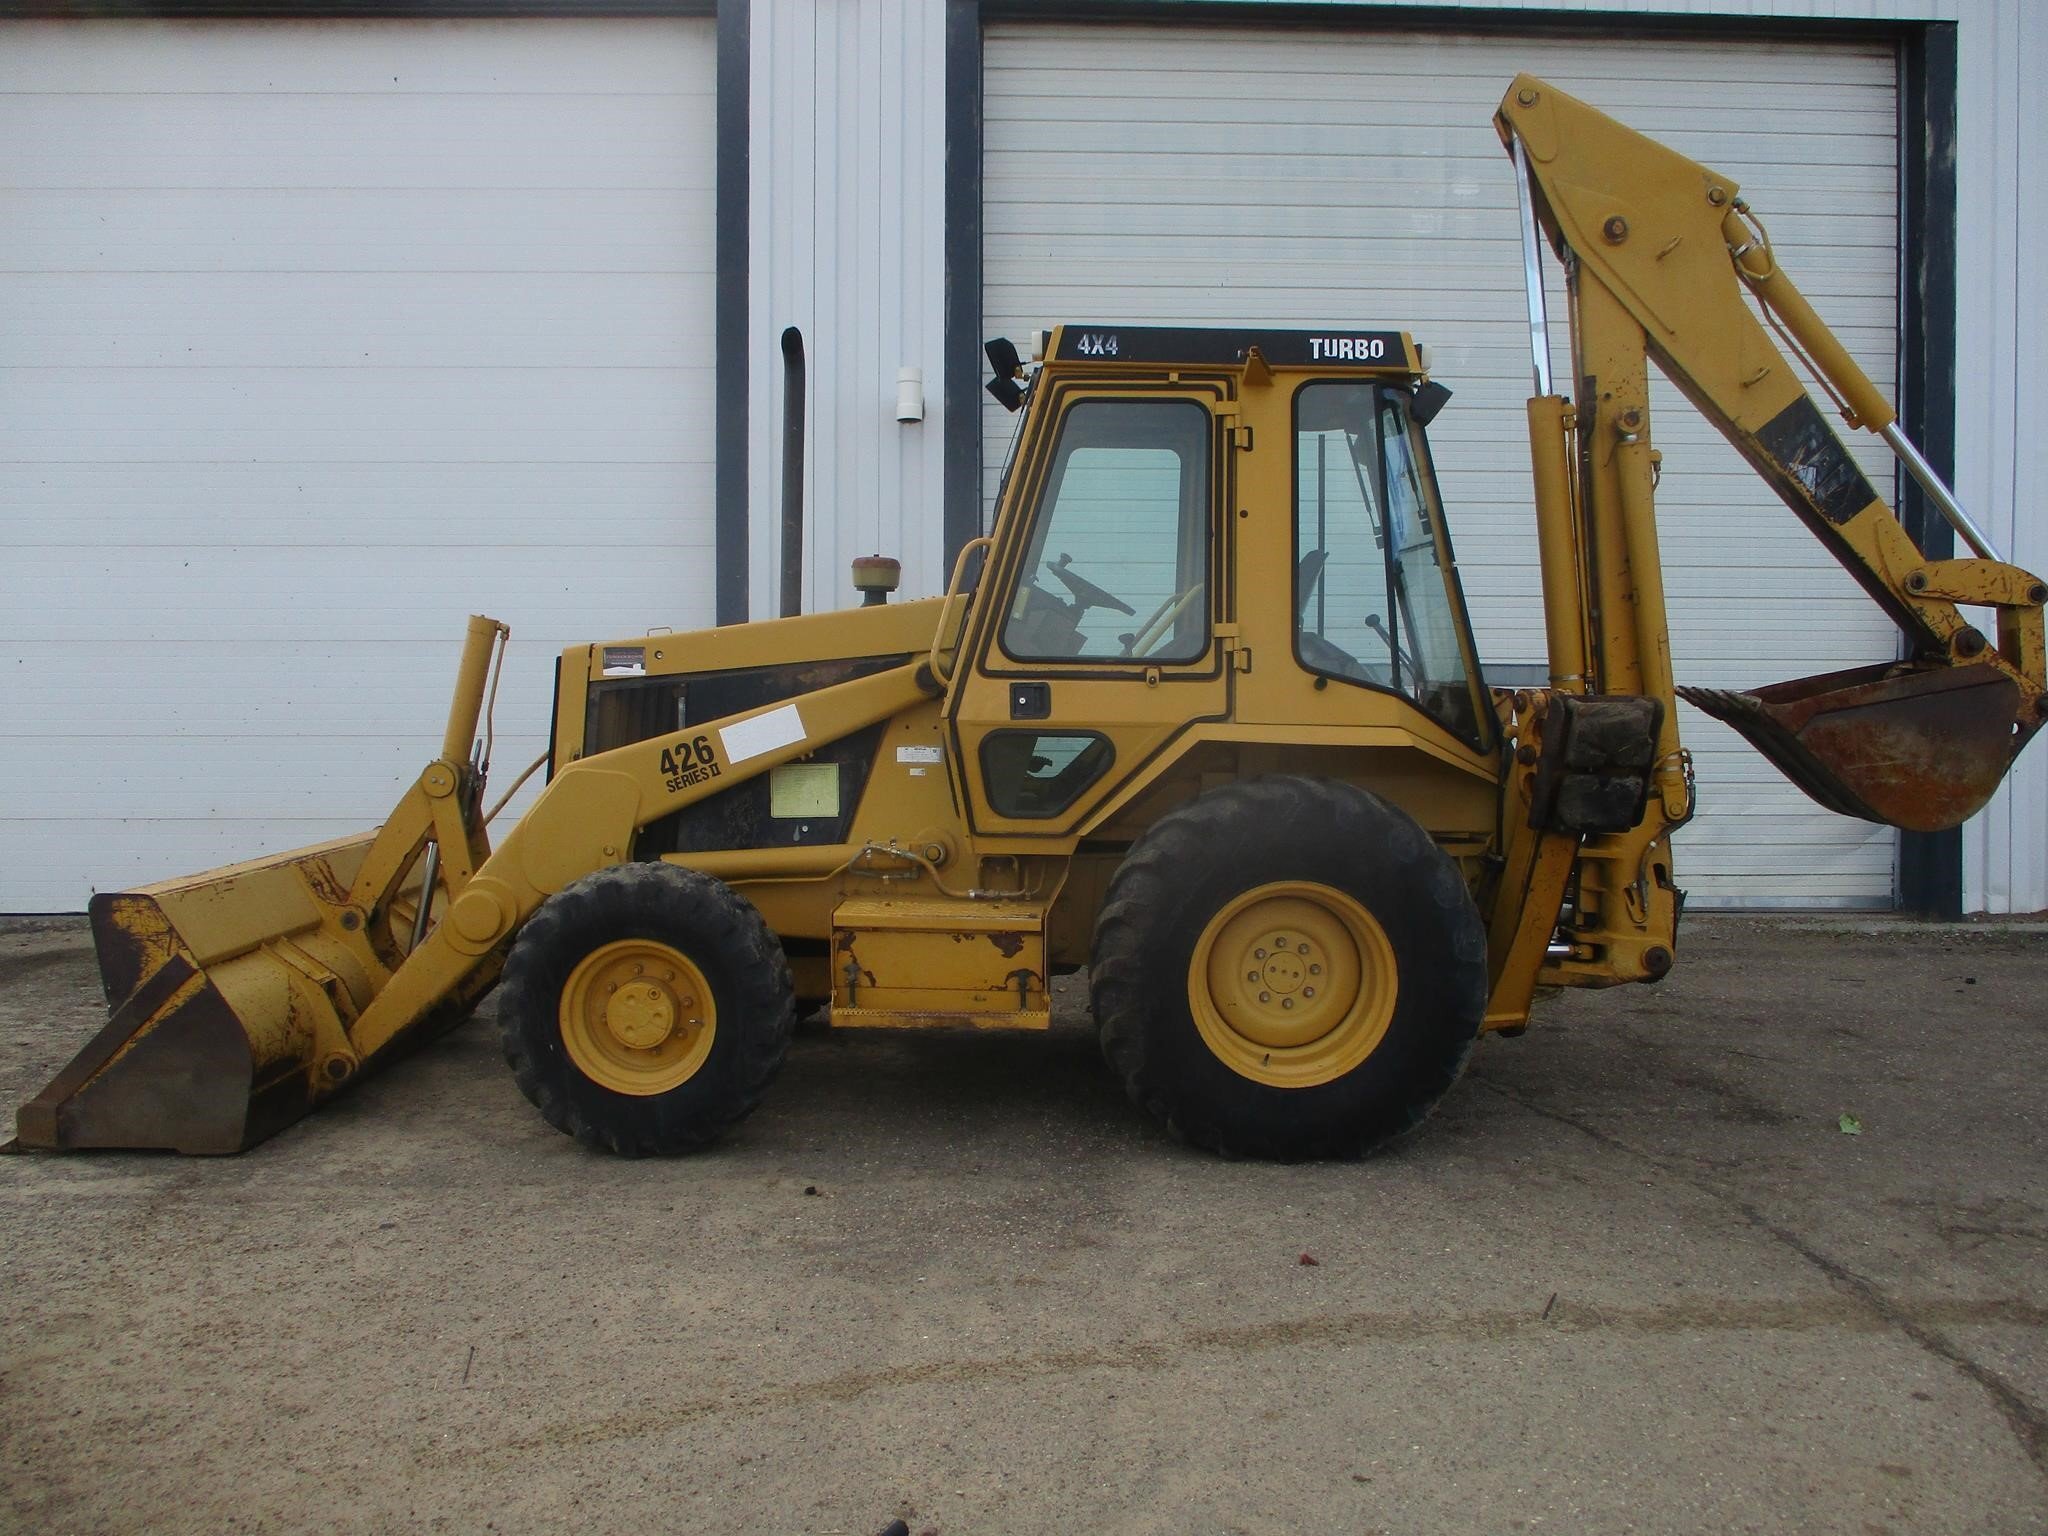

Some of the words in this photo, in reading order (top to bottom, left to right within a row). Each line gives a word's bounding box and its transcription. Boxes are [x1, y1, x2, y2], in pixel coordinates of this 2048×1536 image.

[1078, 334, 1118, 355] 4X4
[1309, 338, 1384, 360] TURBO
[660, 735, 714, 776] 426
[666, 767, 709, 793] SERIES
[709, 762, 721, 777] II
